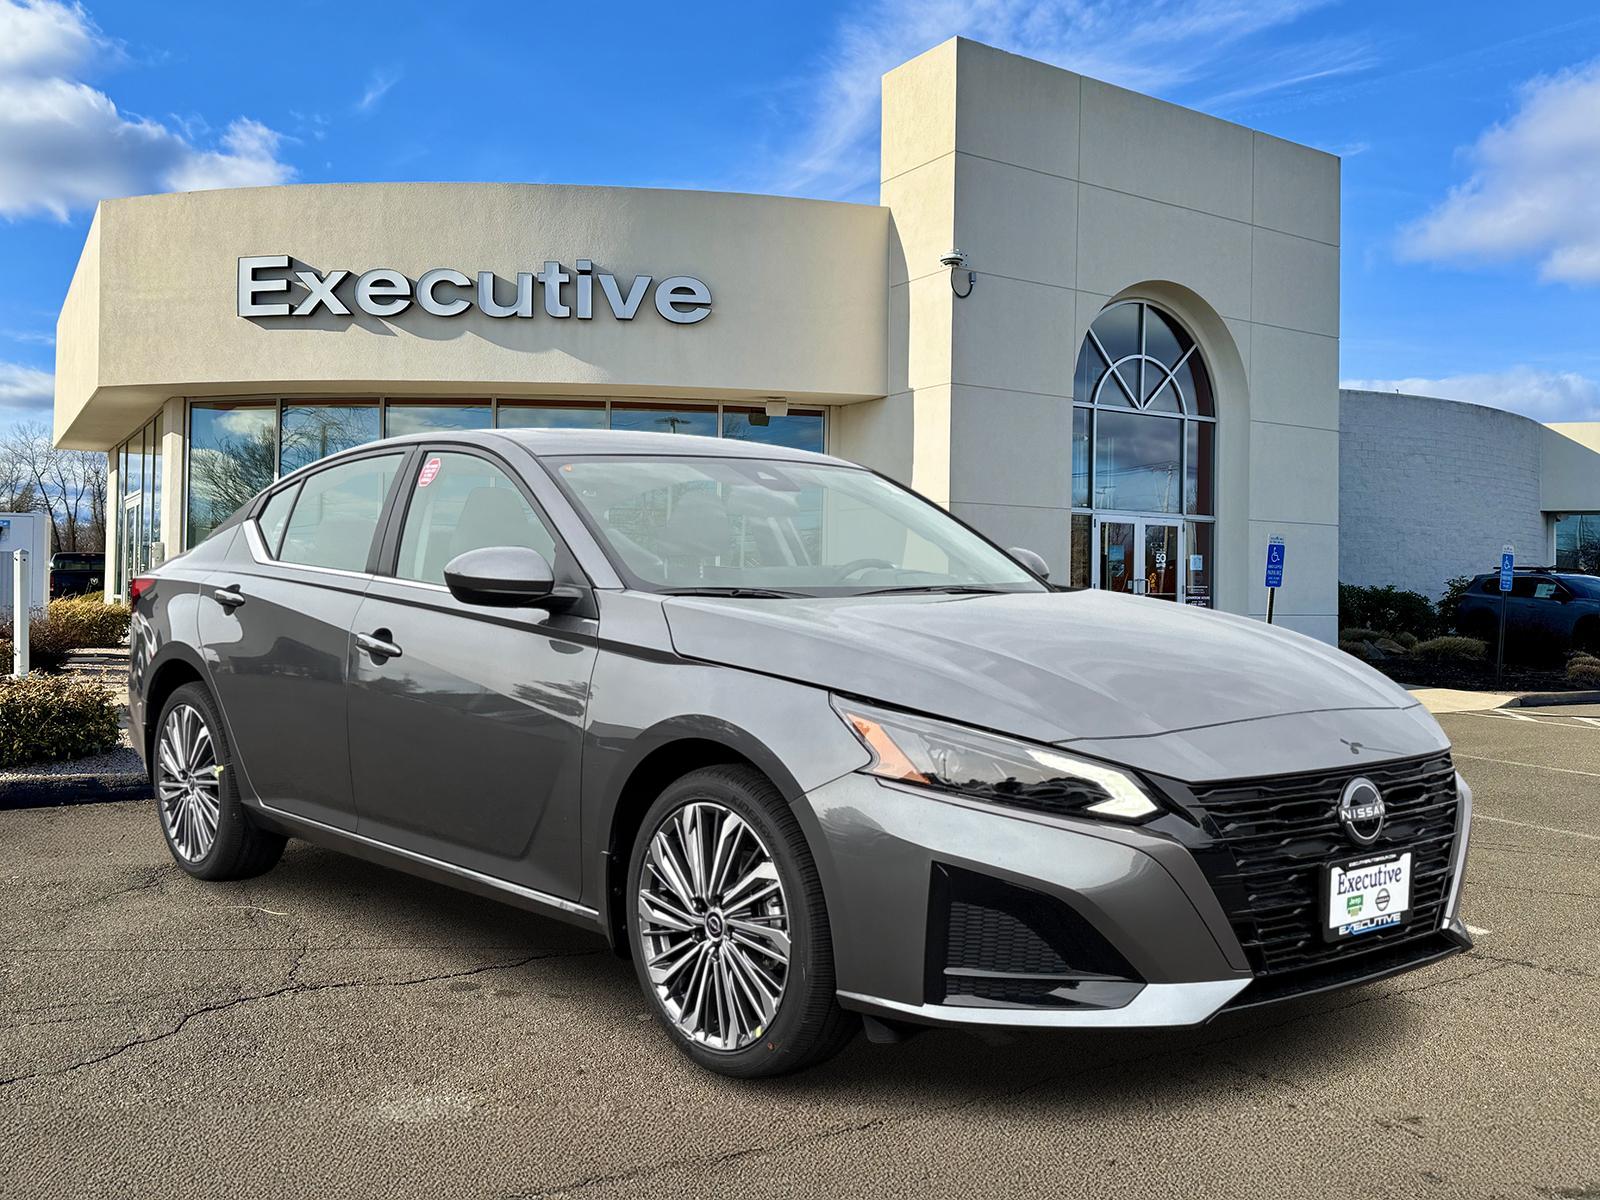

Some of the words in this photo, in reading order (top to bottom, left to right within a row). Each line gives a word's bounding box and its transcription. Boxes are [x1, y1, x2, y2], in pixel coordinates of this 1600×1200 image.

[237, 255, 713, 325] Executive
[1340, 803, 1386, 820] NISSAN
[1336, 864, 1402, 896] Executive
[1338, 912, 1402, 936] EXECUTIVE
